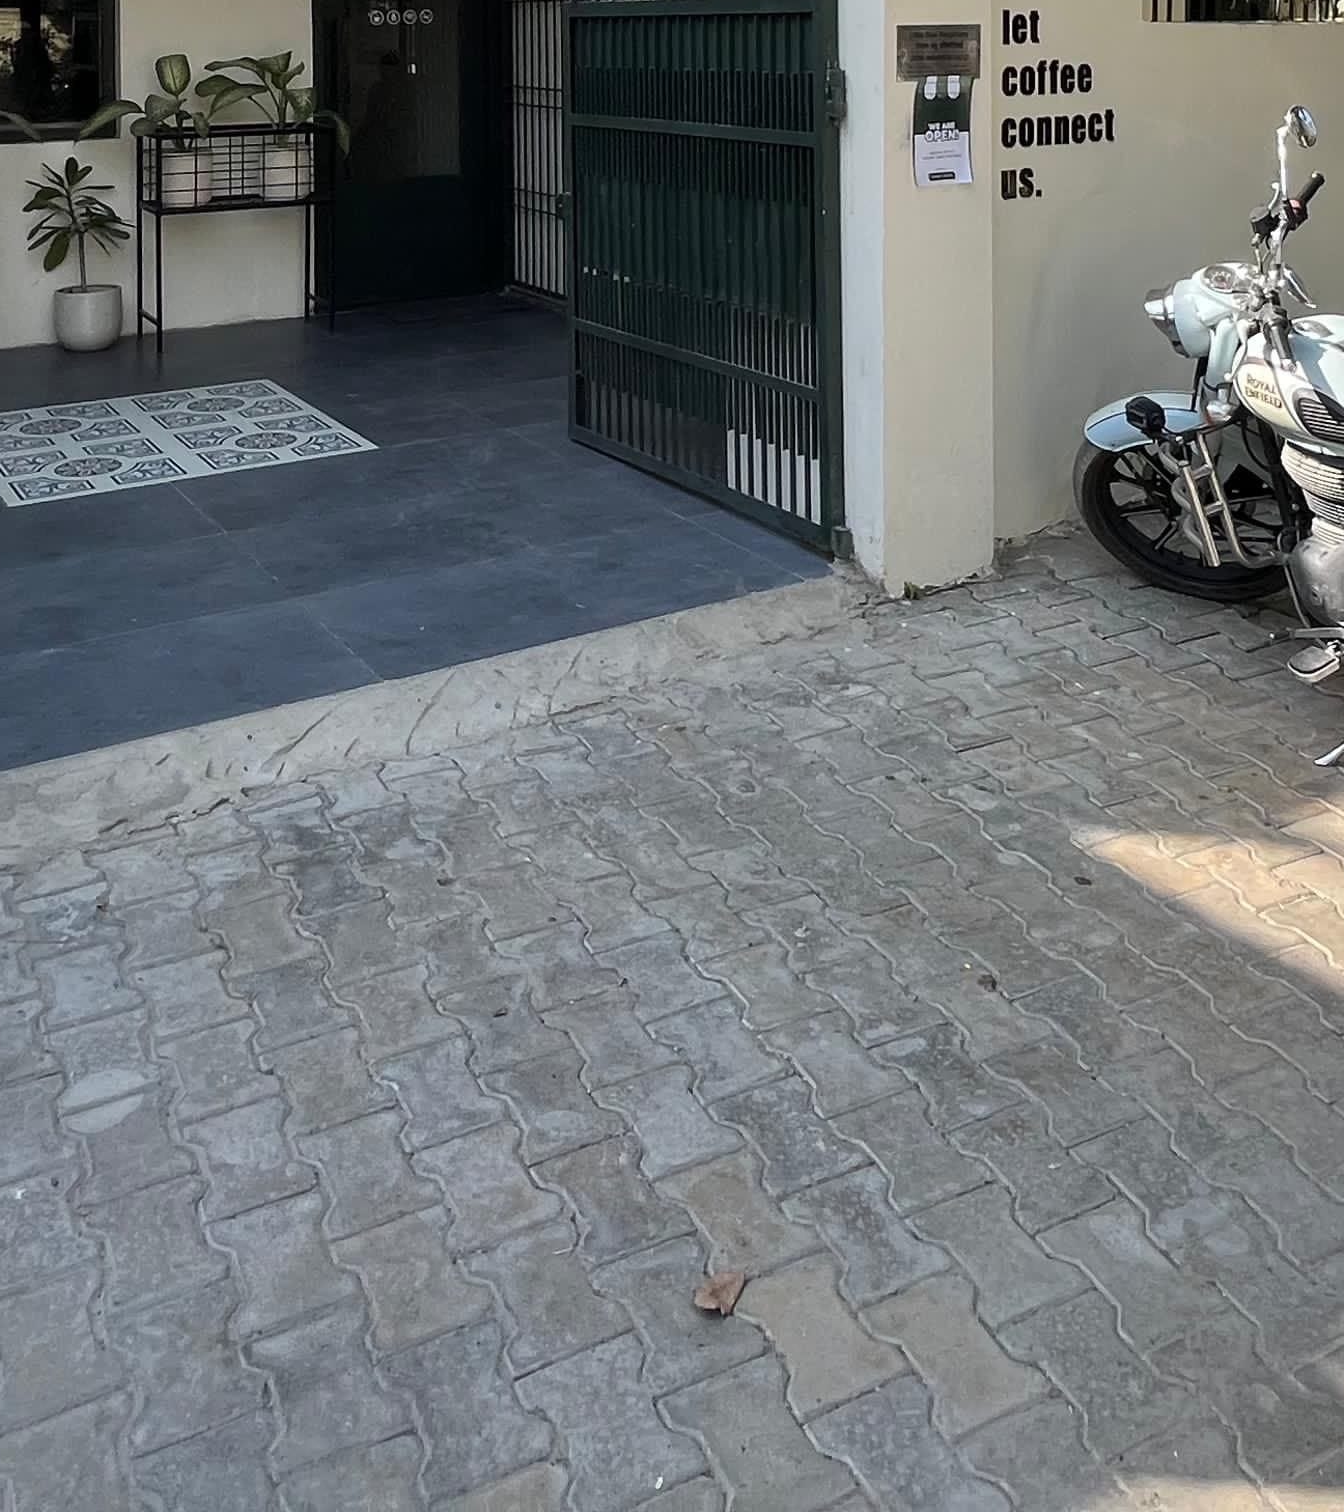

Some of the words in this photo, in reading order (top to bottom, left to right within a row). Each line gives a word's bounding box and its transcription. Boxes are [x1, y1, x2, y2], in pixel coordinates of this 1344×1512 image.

[1001, 9, 1040, 45] let
[1001, 59, 1093, 97] coffee
[1001, 109, 1115, 148] connect
[1000, 168, 1043, 200] us.
